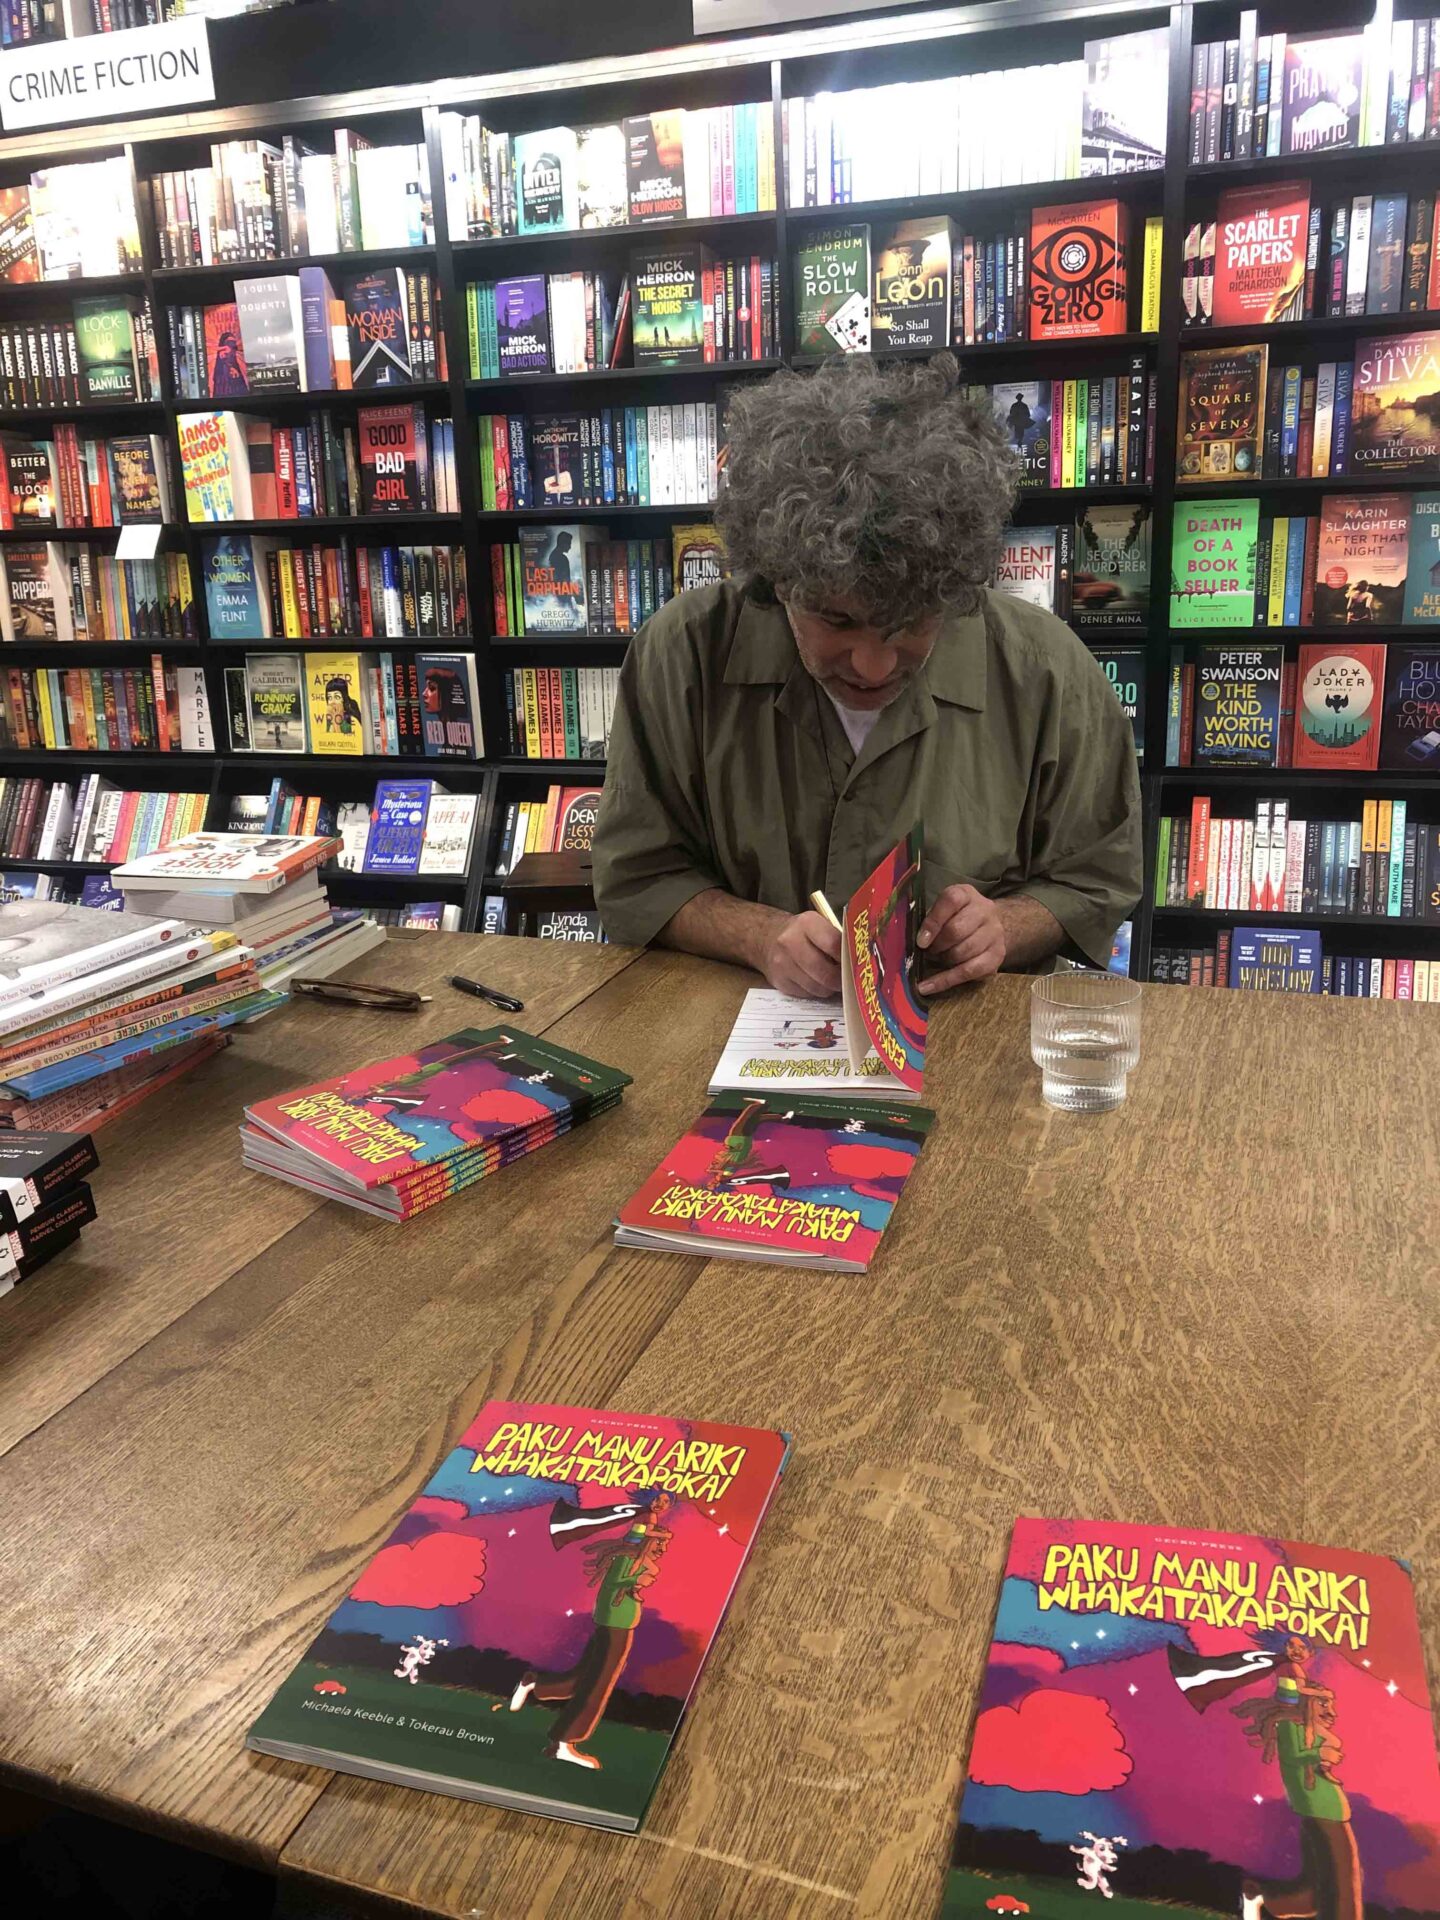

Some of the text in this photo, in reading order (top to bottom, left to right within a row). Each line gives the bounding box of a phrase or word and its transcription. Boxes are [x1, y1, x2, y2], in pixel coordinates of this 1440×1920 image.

[9, 47, 199, 103] CRIME FICTION
[640, 177, 672, 191] MICK
[631, 187, 682, 202] HERRON
[632, 199, 683, 216] SLOW HORSES
[1255, 209, 1269, 218] THE
[1047, 213, 1100, 227] McCARTEN
[808, 230, 852, 242] SIMON
[1224, 214, 1301, 245] SCARLET
[798, 238, 862, 254] LENDRUM
[1227, 240, 1293, 269] PAPERS
[647, 260, 683, 272] MICK
[803, 261, 857, 280] SLOW
[1236, 266, 1283, 280] MATTHEW
[636, 271, 695, 286] HERRON
[1229, 278, 1287, 293] RICHARDSON
[243, 283, 279, 294] LOUISE
[638, 284, 694, 301] THE SECRET
[806, 280, 855, 296] ROLL
[876, 271, 944, 304] Leon
[1031, 279, 1116, 306] GOING
[240, 301, 287, 312] DOUGHTY
[652, 301, 682, 315] HOURS
[1041, 300, 1104, 325] ZERO
[1147, 290, 1155, 322] STATION
[347, 306, 402, 327] WOMAN
[82, 315, 123, 333] LOCK-
[891, 319, 929, 331] So Shall
[359, 323, 397, 341] INSIDE
[888, 333, 932, 345] You Reap
[508, 335, 537, 346] MICK
[501, 344, 546, 356] HERRON
[1374, 344, 1429, 360] DANIEL
[502, 355, 547, 369] BAD ACTORS
[1209, 361, 1237, 369] LAURA
[253, 370, 292, 380] WINTER
[1360, 356, 1440, 384] SILVA
[88, 375, 132, 391] BANVILLE
[1189, 393, 1251, 407] SQUARE
[1318, 378, 1330, 412] SILVA
[360, 406, 413, 418] ALICE FEENEY
[1285, 397, 1296, 431] FALLOUT
[179, 415, 220, 445] JAMES
[1190, 418, 1249, 432] SEVENS
[369, 424, 407, 447] GOOD
[532, 433, 579, 444] HOROWITZ
[182, 432, 226, 462] ELLROY
[1387, 439, 1403, 447] THE
[114, 450, 150, 461] BEFORE
[1354, 445, 1438, 461] COLLECTOR
[10, 457, 46, 468] BETTER
[123, 463, 142, 474] YOU
[375, 452, 405, 474] BAD
[24, 472, 36, 480] THE
[122, 476, 149, 485] KNEW
[14, 485, 49, 495] BLOOD
[283, 482, 291, 509] Perfidia
[374, 478, 409, 500] GIRL
[126, 500, 152, 510] NAME
[1345, 508, 1388, 519] KARIN
[1187, 518, 1242, 533] DEATH
[1325, 519, 1407, 531] SLAUGHTER
[1103, 539, 1125, 549] THE
[1194, 540, 1234, 552] OF A
[1325, 533, 1406, 545] AFTER THAT
[1000, 546, 1053, 564] SILENT
[1086, 549, 1141, 561] SECOND
[1343, 546, 1384, 556] NIGHT
[212, 554, 244, 568] OTHER
[1080, 560, 1146, 573] MURDERER
[1187, 558, 1238, 572] BOOK
[209, 572, 250, 584] WOMEN
[526, 567, 556, 582] LAST
[996, 564, 1053, 582] PATIENT
[12, 581, 49, 600] RIPPER
[527, 581, 580, 596] ORPHAN
[1184, 579, 1239, 593] SELLER
[216, 595, 248, 606] EMMA
[221, 610, 247, 622] FLINT
[541, 610, 570, 619] GREGG
[1176, 616, 1205, 624] ALICE
[536, 618, 575, 628] HURWITZ
[1219, 653, 1262, 665] PETER
[1201, 668, 1280, 681] SWANSON
[1320, 668, 1360, 676] LADY
[252, 675, 296, 685] GALBRAITH
[525, 671, 534, 701] PETER
[1313, 678, 1365, 686] JOKER
[254, 693, 296, 703] RUNNING
[311, 692, 325, 702] SHE
[1224, 684, 1257, 699] THE
[194, 671, 206, 748] MARPLE
[260, 703, 292, 715] GRAVE
[1217, 700, 1262, 715] KIND
[1204, 717, 1272, 732] WORTH
[426, 721, 472, 747] RED QUEEN
[1204, 732, 1271, 749] SAVING
[381, 799, 422, 810] Mysterious
[391, 809, 409, 820] Case
[431, 810, 470, 825] APPEAL
[190, 852, 248, 862] PETS
[370, 854, 391, 864] Janice
[162, 859, 243, 870] HOUSE
[1392, 864, 1400, 882] RUTH
[1403, 840, 1415, 908] WINTER COUNTS
[551, 912, 588, 928] Lynda
[541, 925, 594, 942] Plante
[114, 1010, 179, 1040] WHO LIVES HERE?
[308, 1113, 364, 1142] MANU
[344, 1132, 405, 1164] PAKU
[649, 1197, 856, 1242] PAKU MANU ARIKI
[590, 1418, 659, 1430] GECKO PRESS
[484, 1422, 747, 1477] PAKU MANU ARIKI
[1154, 1536, 1244, 1551] GECKO PRESS
[1042, 1542, 1371, 1616] PAKU MANU ARIKI
[301, 1699, 496, 1746] Michaela Keeble & Tokerau Brown
